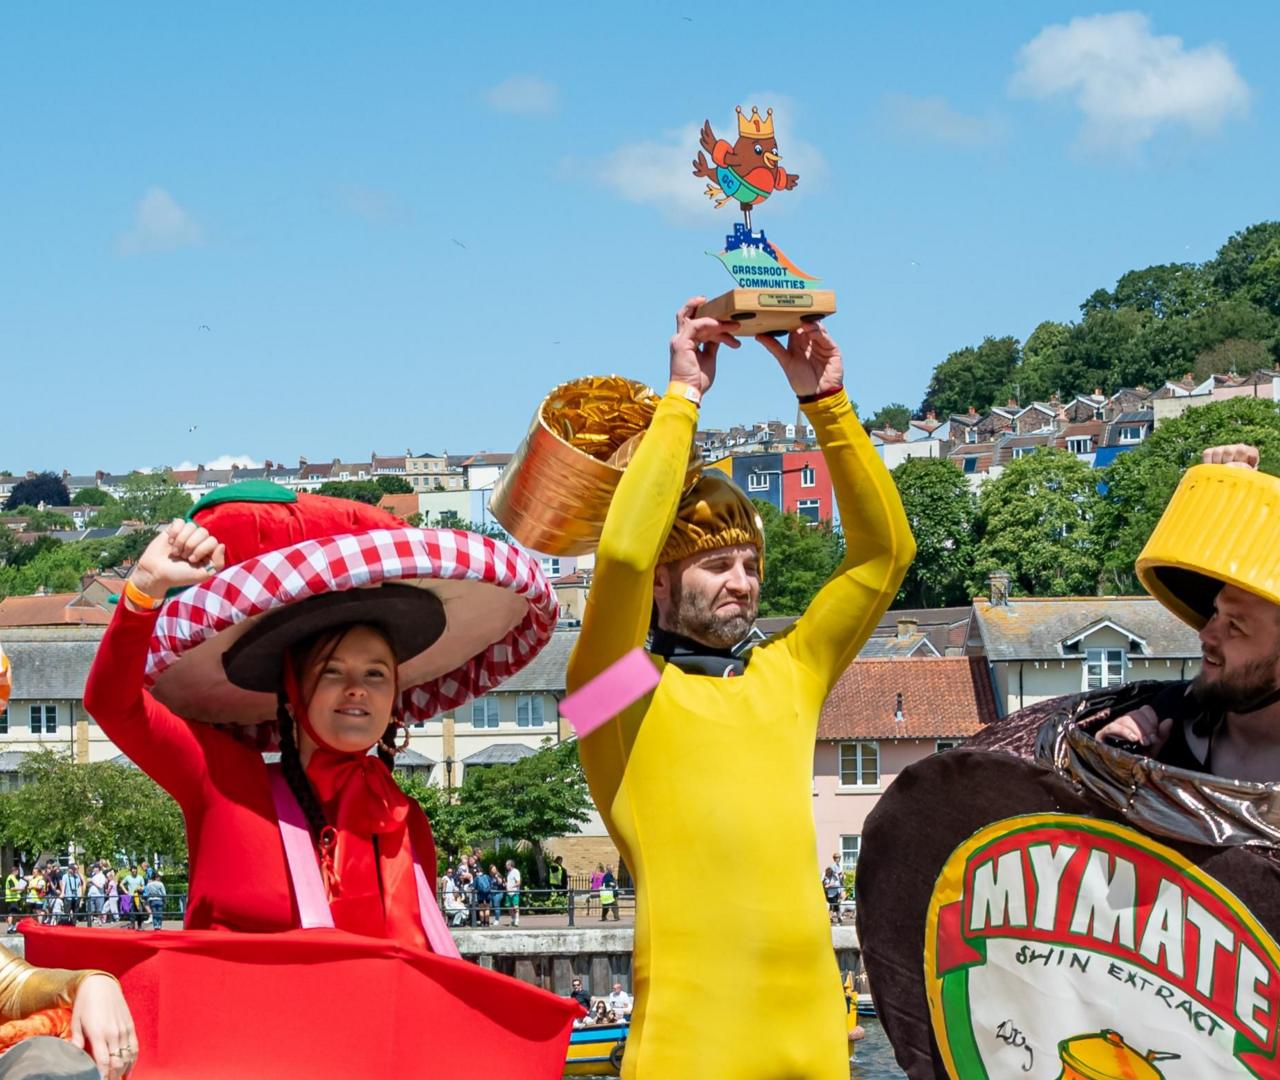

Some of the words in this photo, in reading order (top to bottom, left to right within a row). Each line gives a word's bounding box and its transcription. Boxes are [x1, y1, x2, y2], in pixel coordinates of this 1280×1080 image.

[721, 173, 735, 190] GC
[732, 265, 788, 277] GRASSROOT
[738, 278, 806, 290] COMMUNITIES
[969, 842, 1271, 1046] MYMATE
[1015, 944, 1092, 974] SHIN
[1107, 964, 1226, 1038] EXTRACT
